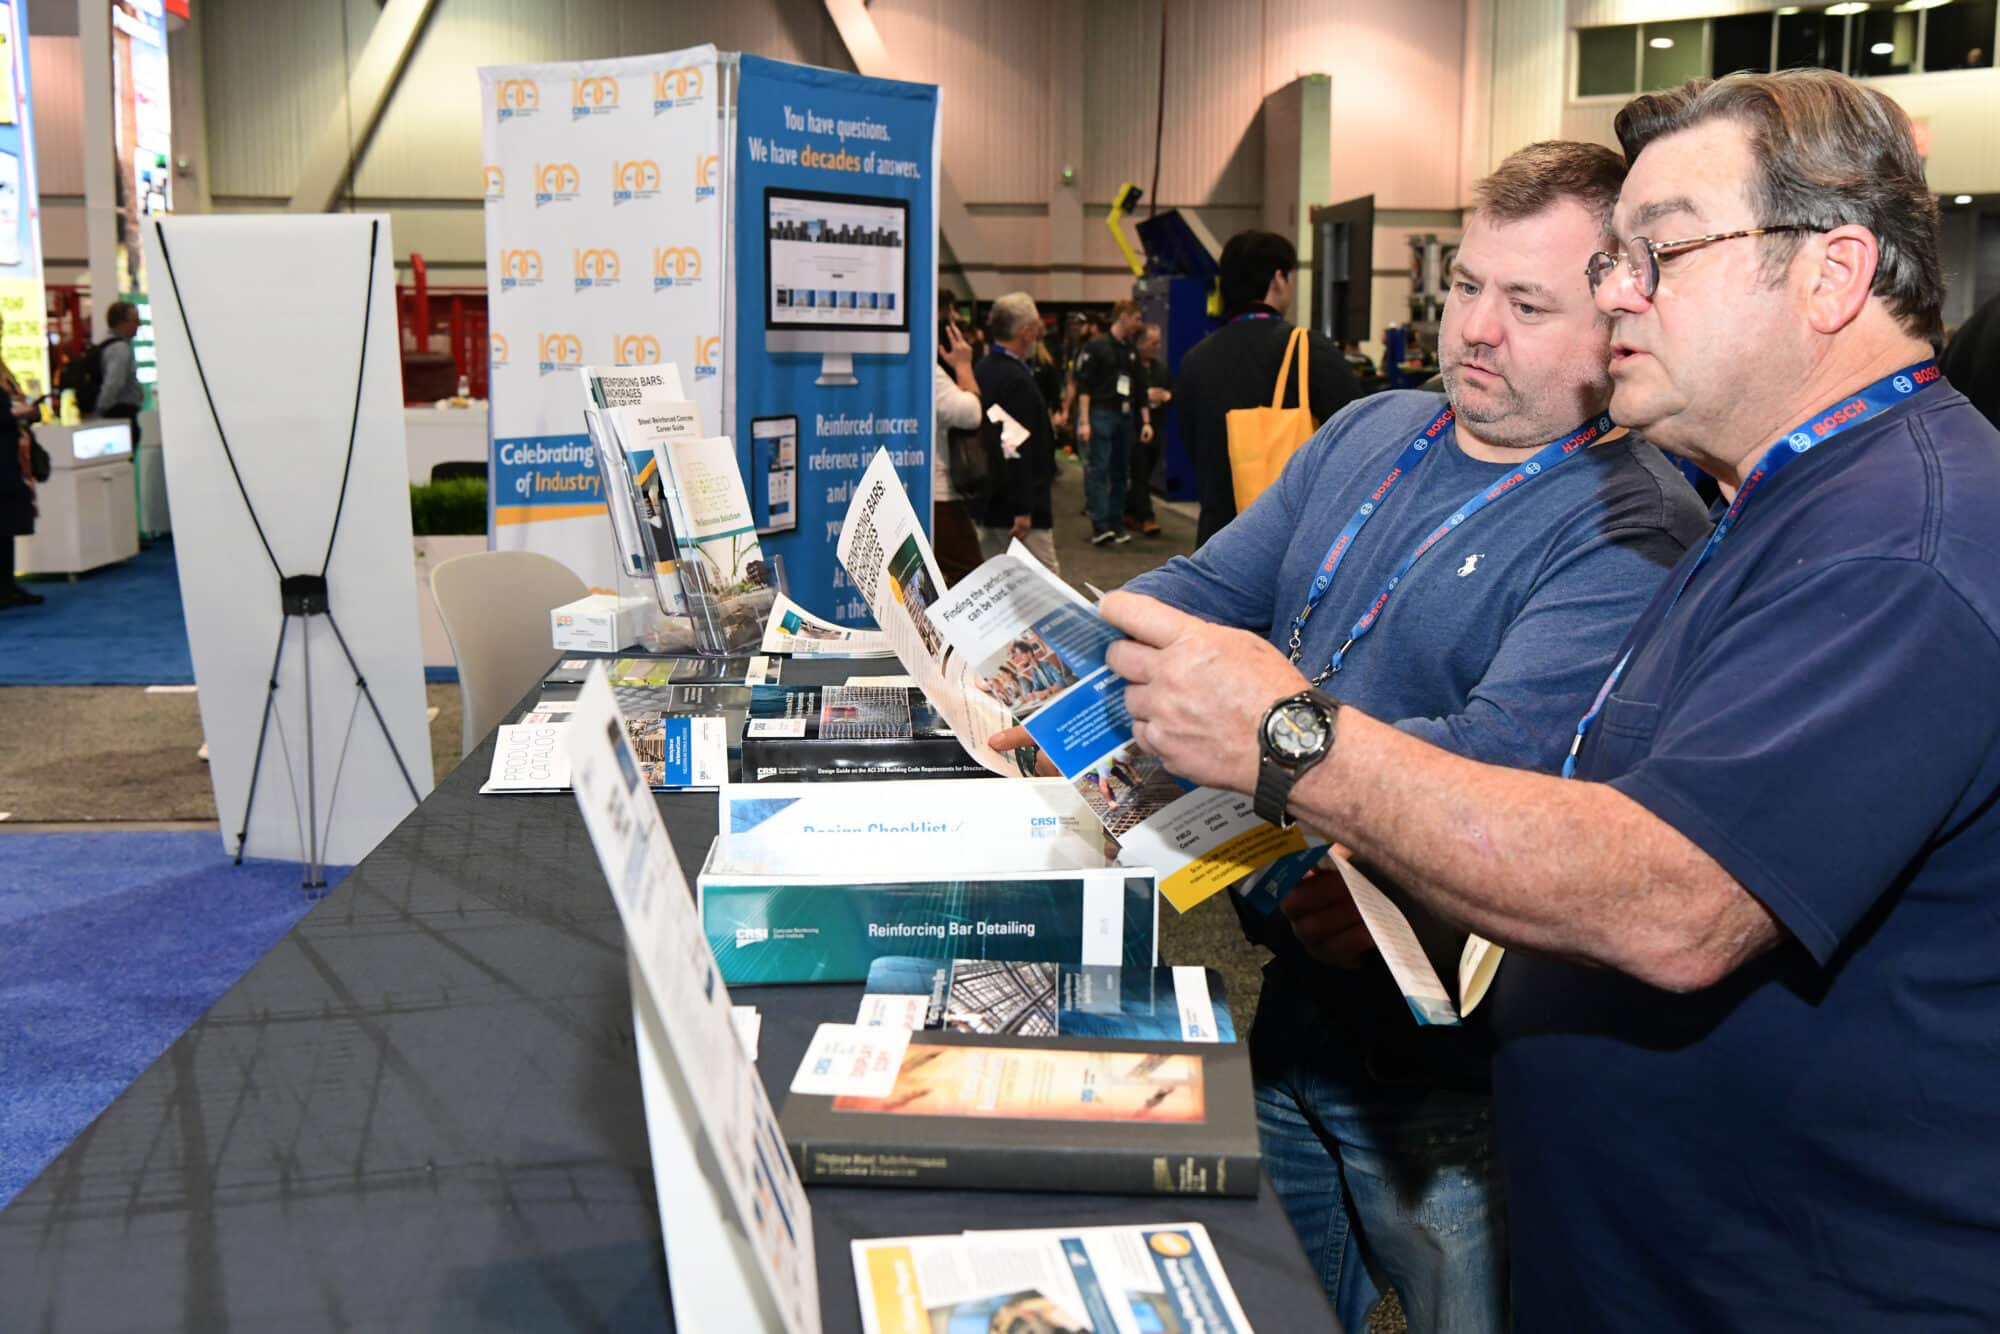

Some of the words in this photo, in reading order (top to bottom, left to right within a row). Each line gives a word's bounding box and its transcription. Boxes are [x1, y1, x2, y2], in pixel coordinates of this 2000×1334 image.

[784, 106, 805, 131] You
[808, 110, 834, 135] have
[837, 117, 891, 142] questions.
[749, 136, 768, 163] We
[771, 140, 797, 166] have
[801, 144, 861, 172] decades
[864, 152, 876, 174] of
[877, 159, 920, 179] answers.
[601, 377, 639, 387] EINFORCING
[641, 376, 665, 387] BARS:
[1912, 365, 1940, 384] BOSC
[816, 412, 873, 437] Reinforced
[1812, 400, 1869, 436] BOSCH
[1562, 426, 1597, 453] BOSCH
[501, 442, 594, 468] Celebrating
[809, 448, 859, 470] reference
[862, 446, 924, 468] infation
[516, 471, 533, 498] of
[536, 470, 600, 497] Industry
[827, 480, 847, 503] and
[1372, 468, 1402, 500] BOSCH
[1486, 473, 1524, 500] BOSCH
[866, 480, 885, 515] BARS:
[1324, 535, 1348, 572] BOSCH
[848, 597, 867, 618] the
[943, 598, 974, 622] Finding
[968, 608, 983, 622] can
[981, 600, 993, 612] be
[1360, 593, 1388, 629] BOSCH
[504, 730, 530, 780] PRODUCT
[529, 729, 556, 780] CATALOG
[758, 767, 777, 775] CRSI
[1031, 816, 1056, 826] CRSI
[736, 929, 768, 939] CRSI
[868, 923, 945, 938] Reinforcing
[950, 922, 973, 935] Bar
[976, 921, 1035, 936] Detailing
